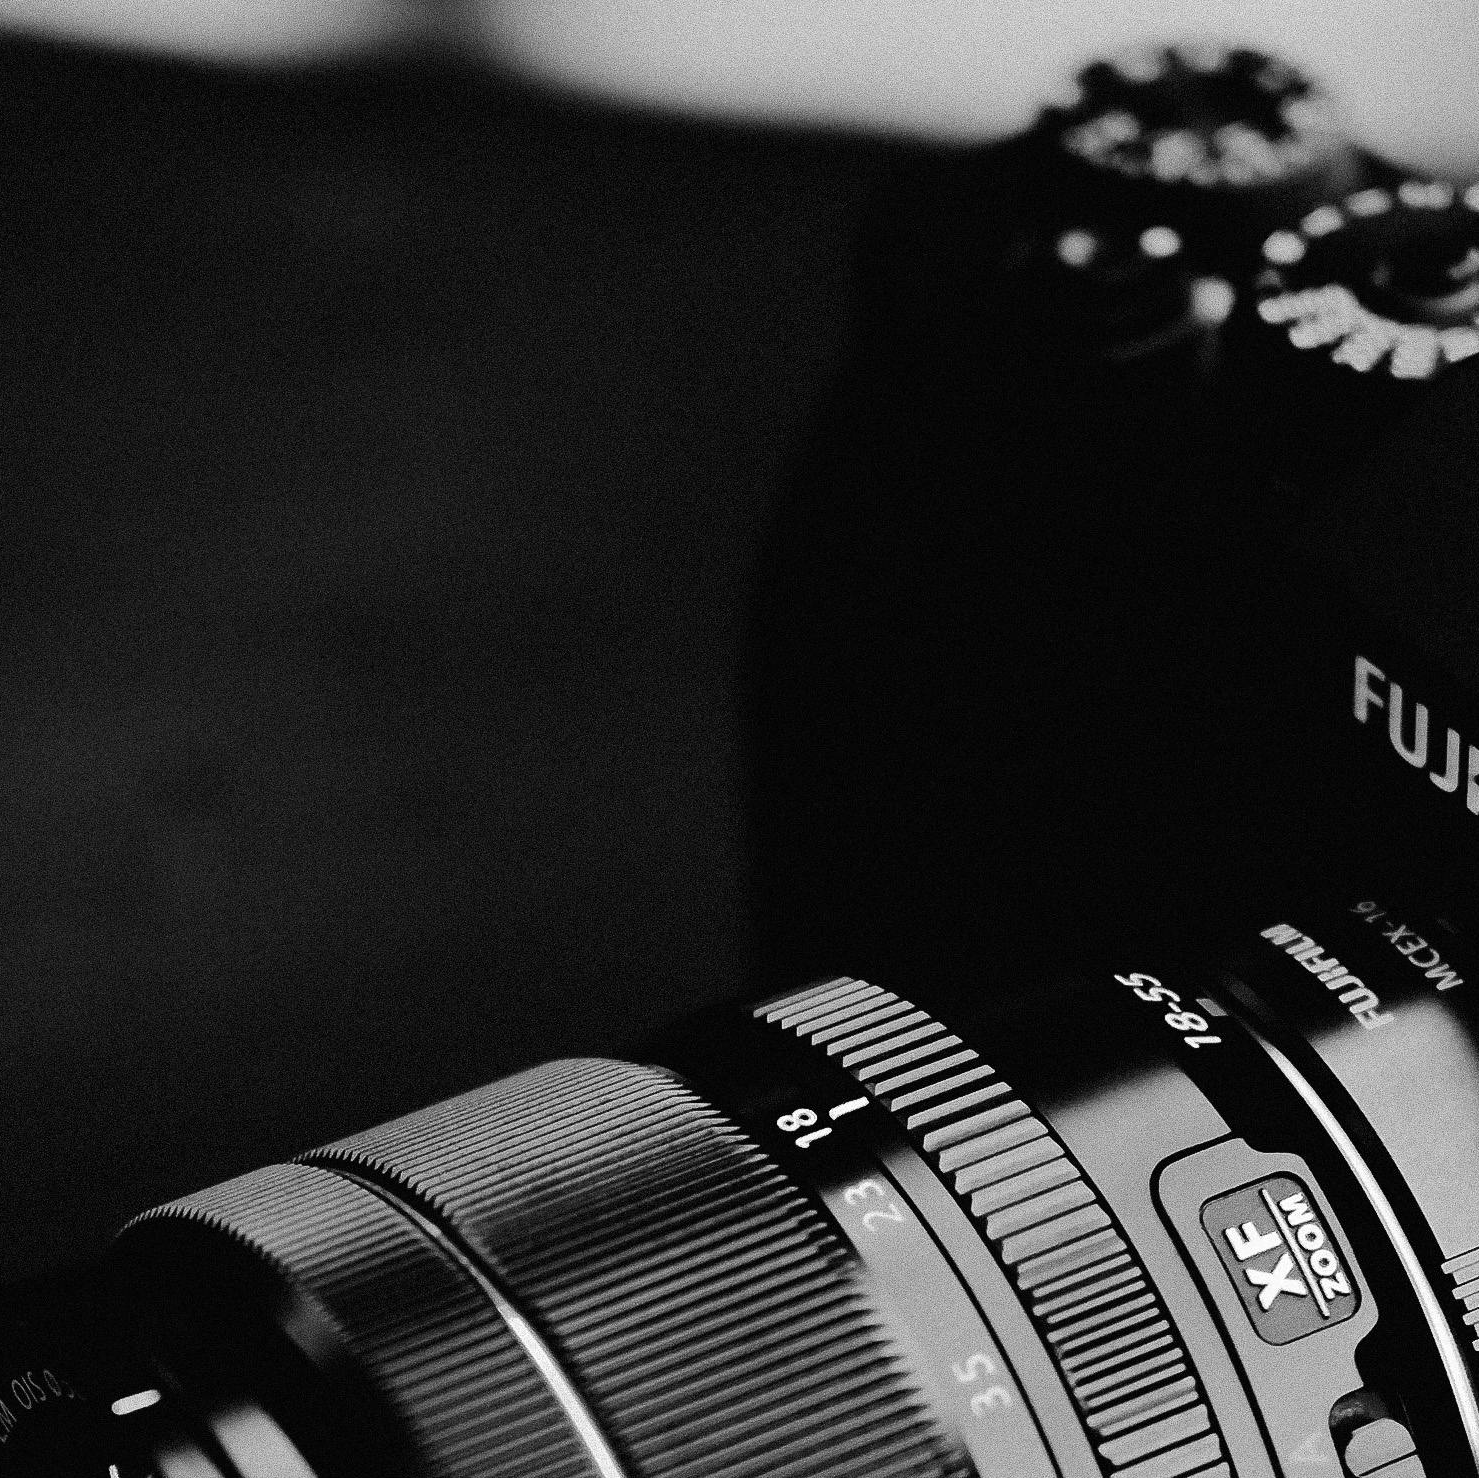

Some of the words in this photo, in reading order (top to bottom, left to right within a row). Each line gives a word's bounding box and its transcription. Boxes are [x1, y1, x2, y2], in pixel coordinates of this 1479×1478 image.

[1259, 923, 1396, 1030] FUJIFILM
[1348, 901, 1464, 991] MCEX-16
[1114, 972, 1223, 1048] 18-55
[776, 1107, 834, 1149] 18
[843, 1178, 905, 1233] 23
[1278, 1191, 1351, 1300] ZOOM
[1225, 1221, 1309, 1311] XF
[951, 1352, 1013, 1418] 35
